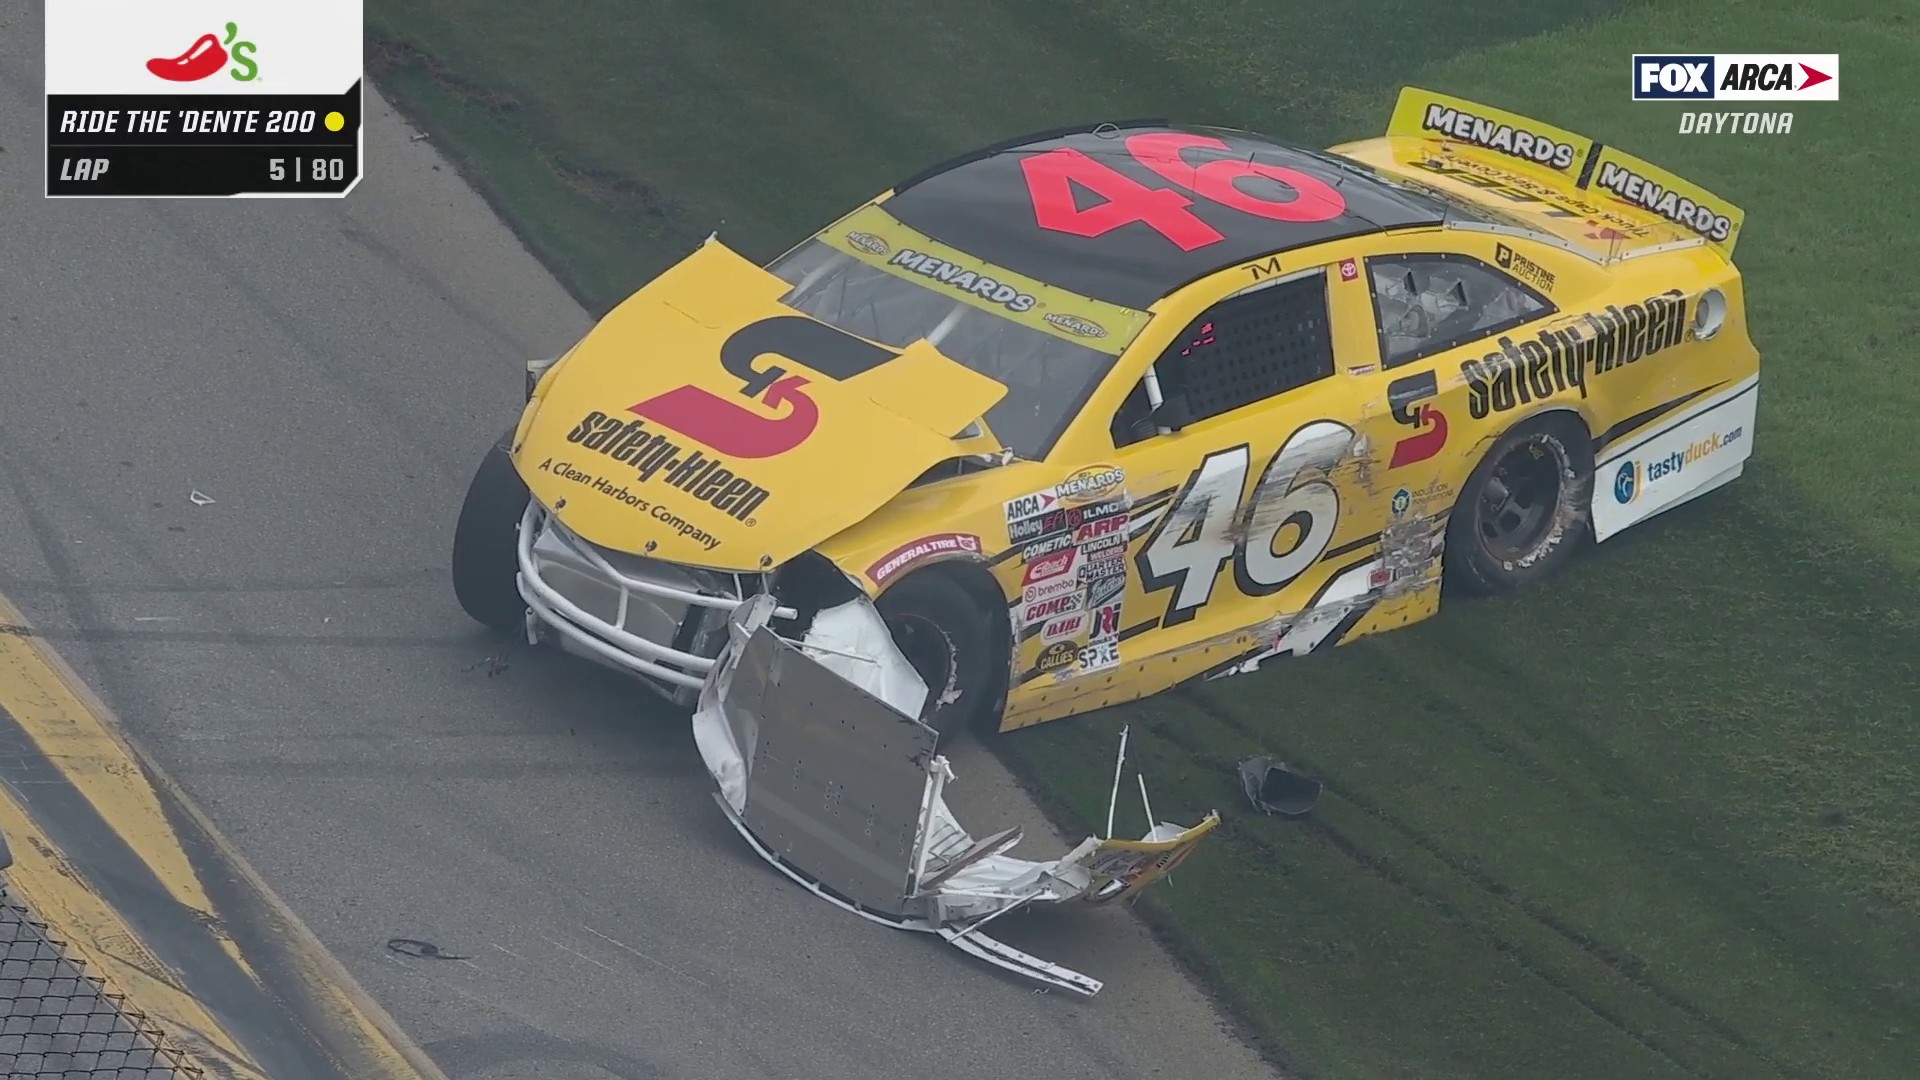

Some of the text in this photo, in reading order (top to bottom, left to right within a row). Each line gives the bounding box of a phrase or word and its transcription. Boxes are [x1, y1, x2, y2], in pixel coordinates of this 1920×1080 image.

[1423, 103, 1575, 170] MENARDS
[1020, 132, 1347, 252] 46
[1600, 161, 1732, 242] MENARDS
[888, 248, 1037, 313] MENARDS
[1512, 263, 1554, 293] AUCTION
[1514, 252, 1556, 285] PRISTINE
[567, 411, 770, 522] safety-kleen
[1647, 426, 1743, 483] tastyduck.com
[1055, 468, 1125, 499] MENARDS
[538, 457, 721, 551] A Clean Harbors Company
[1007, 495, 1040, 521] ARCA
[1083, 500, 1125, 520] ILMO
[1008, 518, 1043, 540] Holley
[1076, 514, 1129, 542] ARP
[1136, 418, 1356, 628] 46
[876, 539, 958, 580] GENERAL TIRE
[1023, 533, 1072, 559] COMETIC
[1082, 534, 1121, 554] LINCOLN
[1038, 579, 1076, 597] brembo
[1026, 597, 1071, 621] COMP
[1041, 650, 1076, 670] CALLIES
